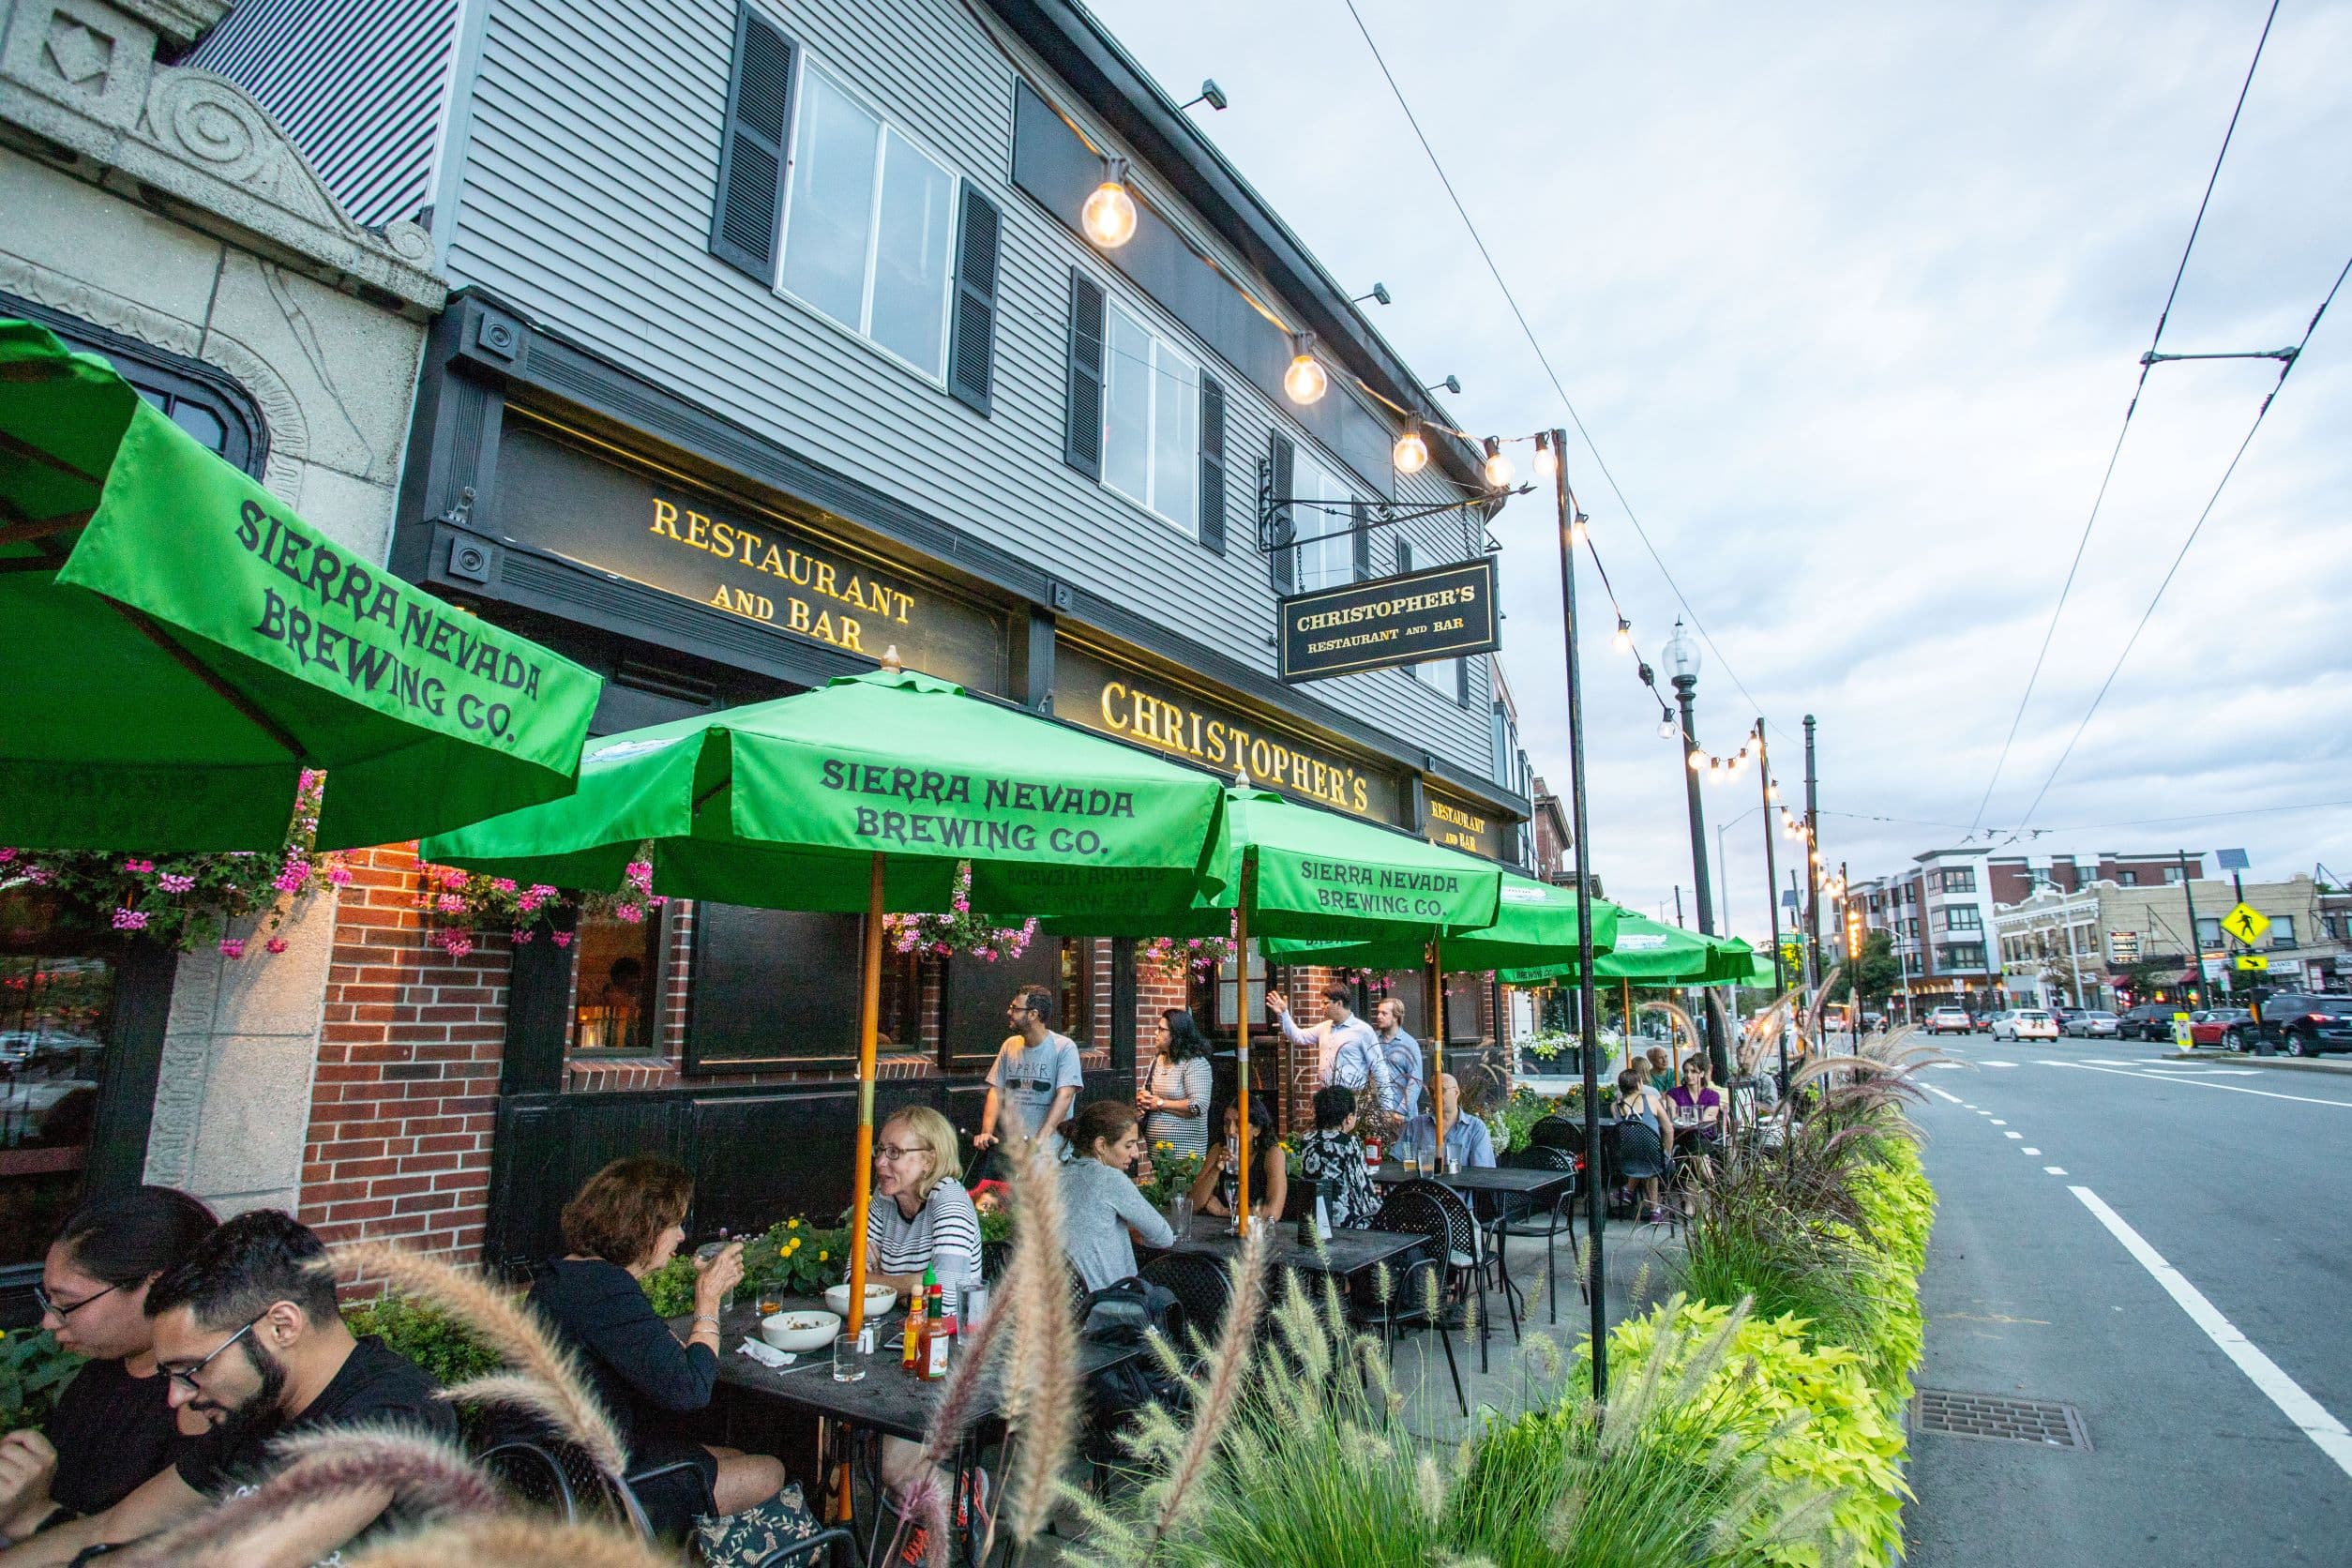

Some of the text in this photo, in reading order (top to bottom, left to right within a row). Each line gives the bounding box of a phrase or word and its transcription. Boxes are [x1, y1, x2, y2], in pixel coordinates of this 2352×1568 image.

[649, 498, 914, 625] RESTAURANT
[235, 499, 542, 701] SIERRA NEVADA
[709, 584, 864, 653] AND BAR
[1296, 585, 1475, 632] CHRISTOPHER'S
[1307, 617, 1464, 654] RESTAURANT AND BAR
[252, 587, 516, 743] BREWING CO.
[1101, 681, 1368, 812] CHRISTOPHER'S
[820, 759, 1135, 819] SIERRA NEVADA
[854, 806, 1108, 855] BREWING CO.
[1430, 800, 1485, 834] RESTAURANT
[1445, 832, 1476, 852] AND BAR
[1301, 861, 1459, 893] SIERRA NEVADA
[1318, 888, 1447, 917] BREWING CO.
